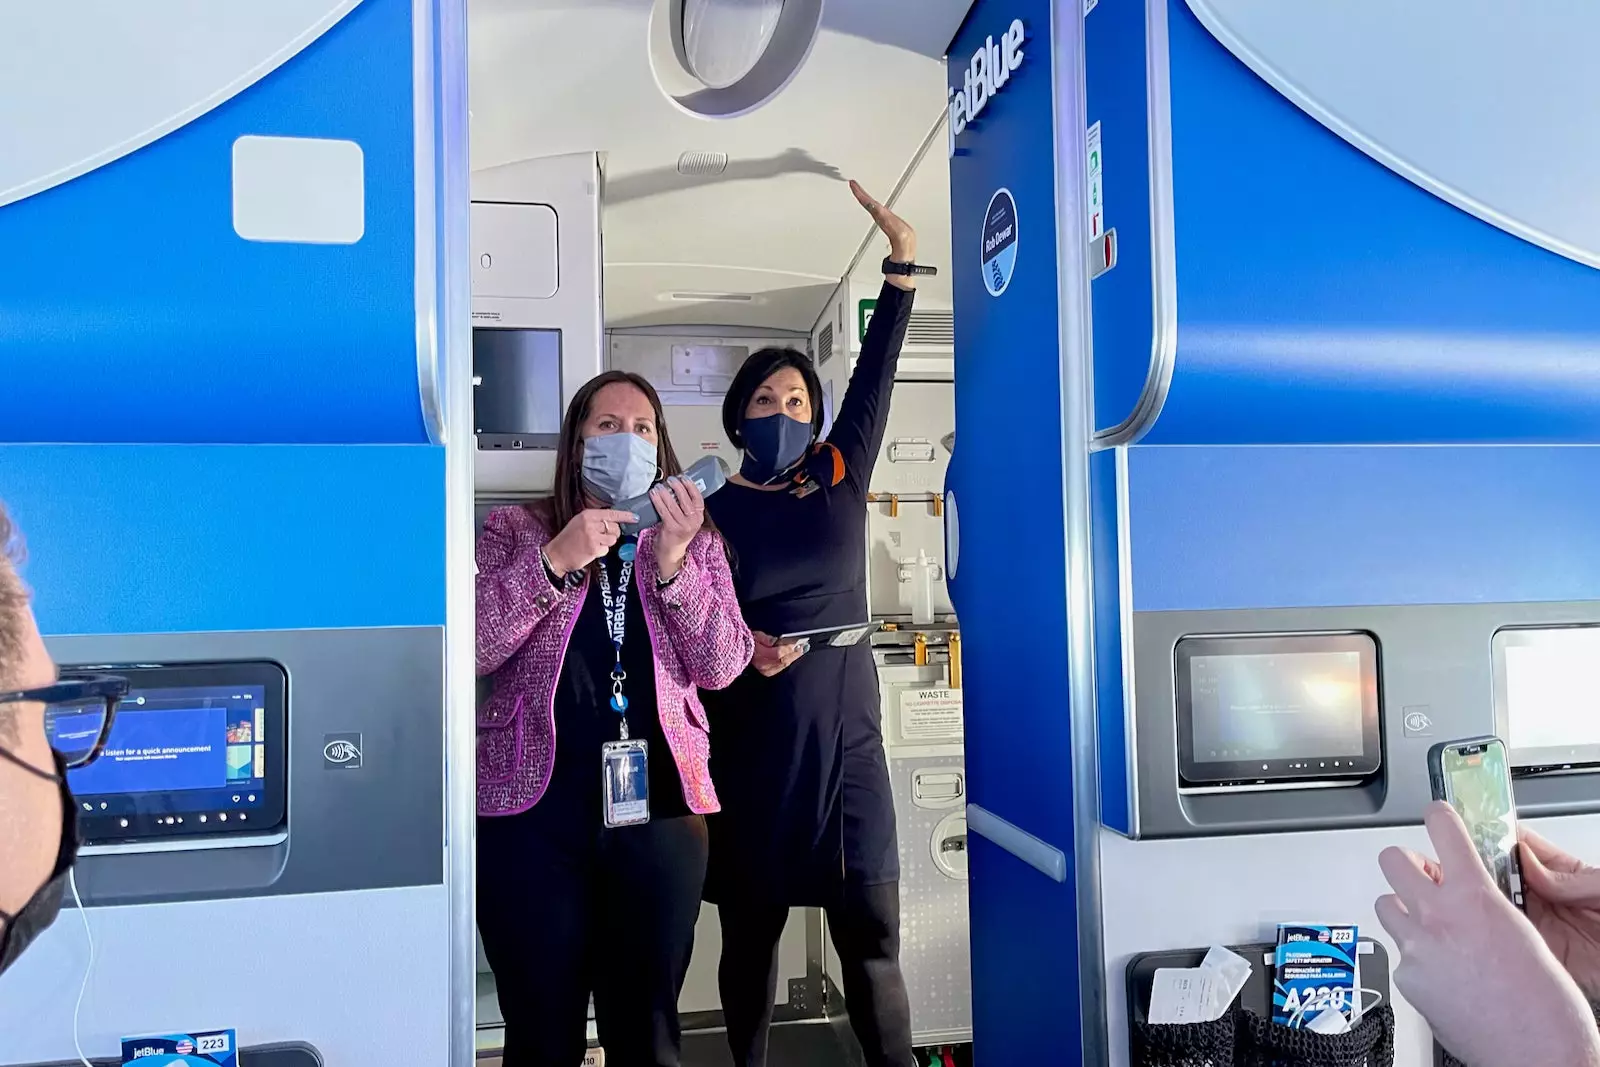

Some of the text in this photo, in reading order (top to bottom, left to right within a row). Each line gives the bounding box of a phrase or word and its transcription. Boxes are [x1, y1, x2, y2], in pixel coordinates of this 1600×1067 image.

[948, 18, 1025, 160] jetBlue
[985, 223, 1013, 254] Rob Dewar
[613, 561, 634, 645] AIRBUS A220
[918, 690, 951, 699] WASTE
[105, 749, 125, 757] listen
[126, 748, 136, 756] for
[142, 747, 161, 756] quick
[162, 744, 212, 754] announcement
[1335, 932, 1350, 941] 223
[1282, 986, 1346, 1013] A220
[133, 1039, 225, 1059] jetBlue 223
